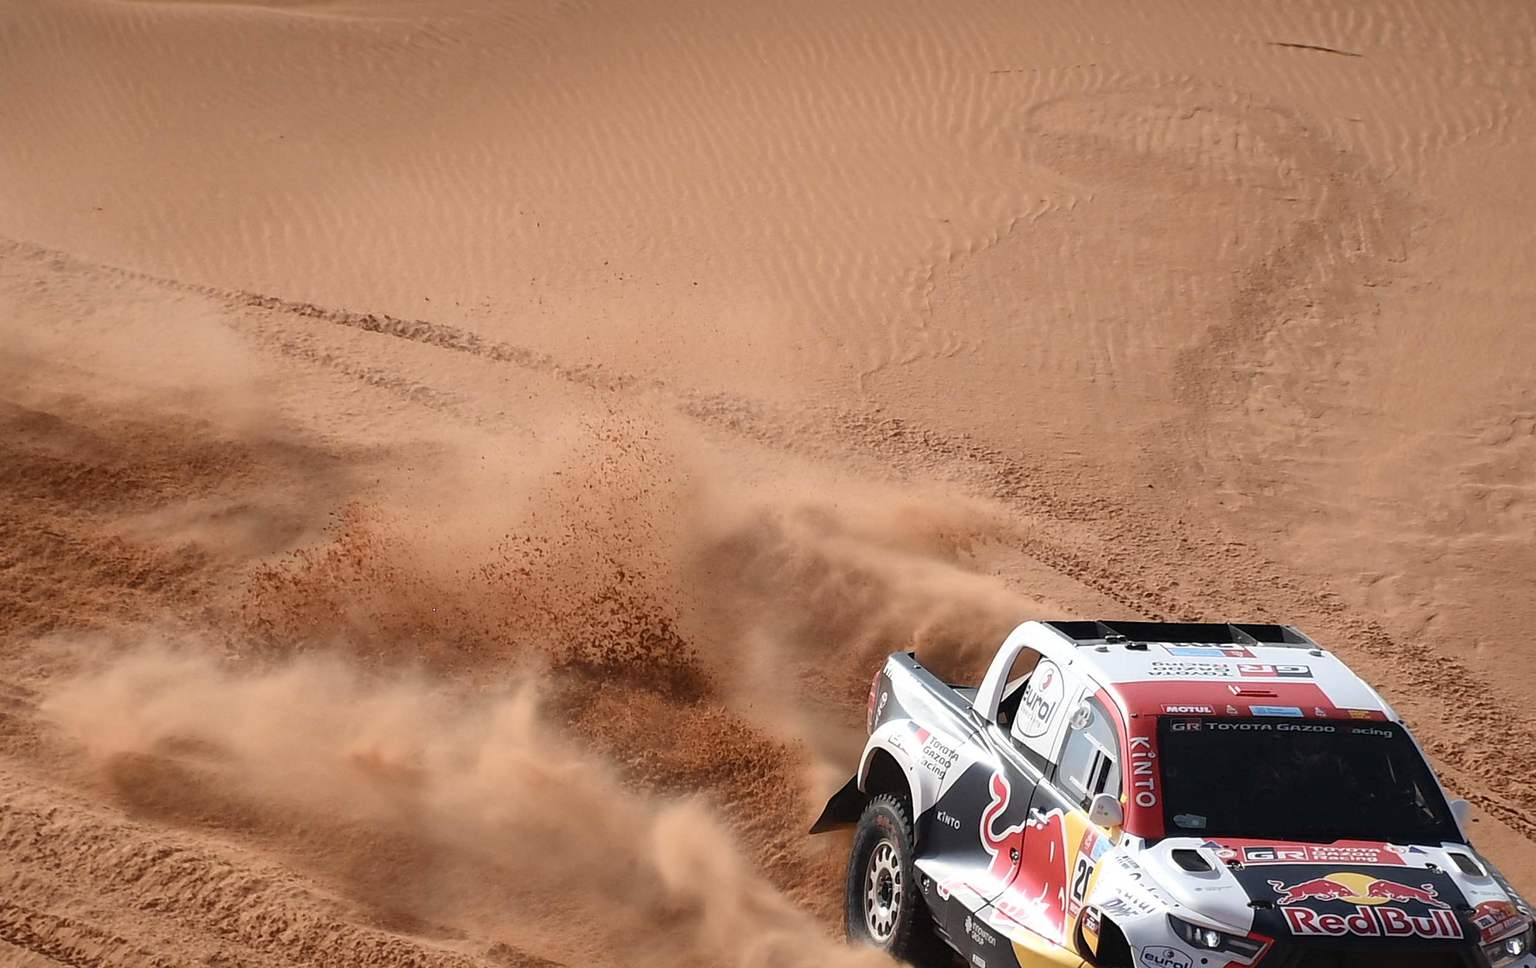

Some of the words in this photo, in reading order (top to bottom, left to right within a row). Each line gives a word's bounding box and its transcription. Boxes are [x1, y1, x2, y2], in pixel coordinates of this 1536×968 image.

[1172, 722, 1201, 731] GR
[1206, 722, 1272, 730] TOYOTA
[1276, 723, 1336, 732] GAZOO
[1346, 727, 1393, 738] acing
[922, 745, 952, 769] GAZOO
[929, 736, 960, 762] TOYOTA
[920, 759, 947, 780] acing
[1247, 850, 1305, 861] GR
[1282, 906, 1379, 935] Red
[1378, 907, 1463, 938] Bull
